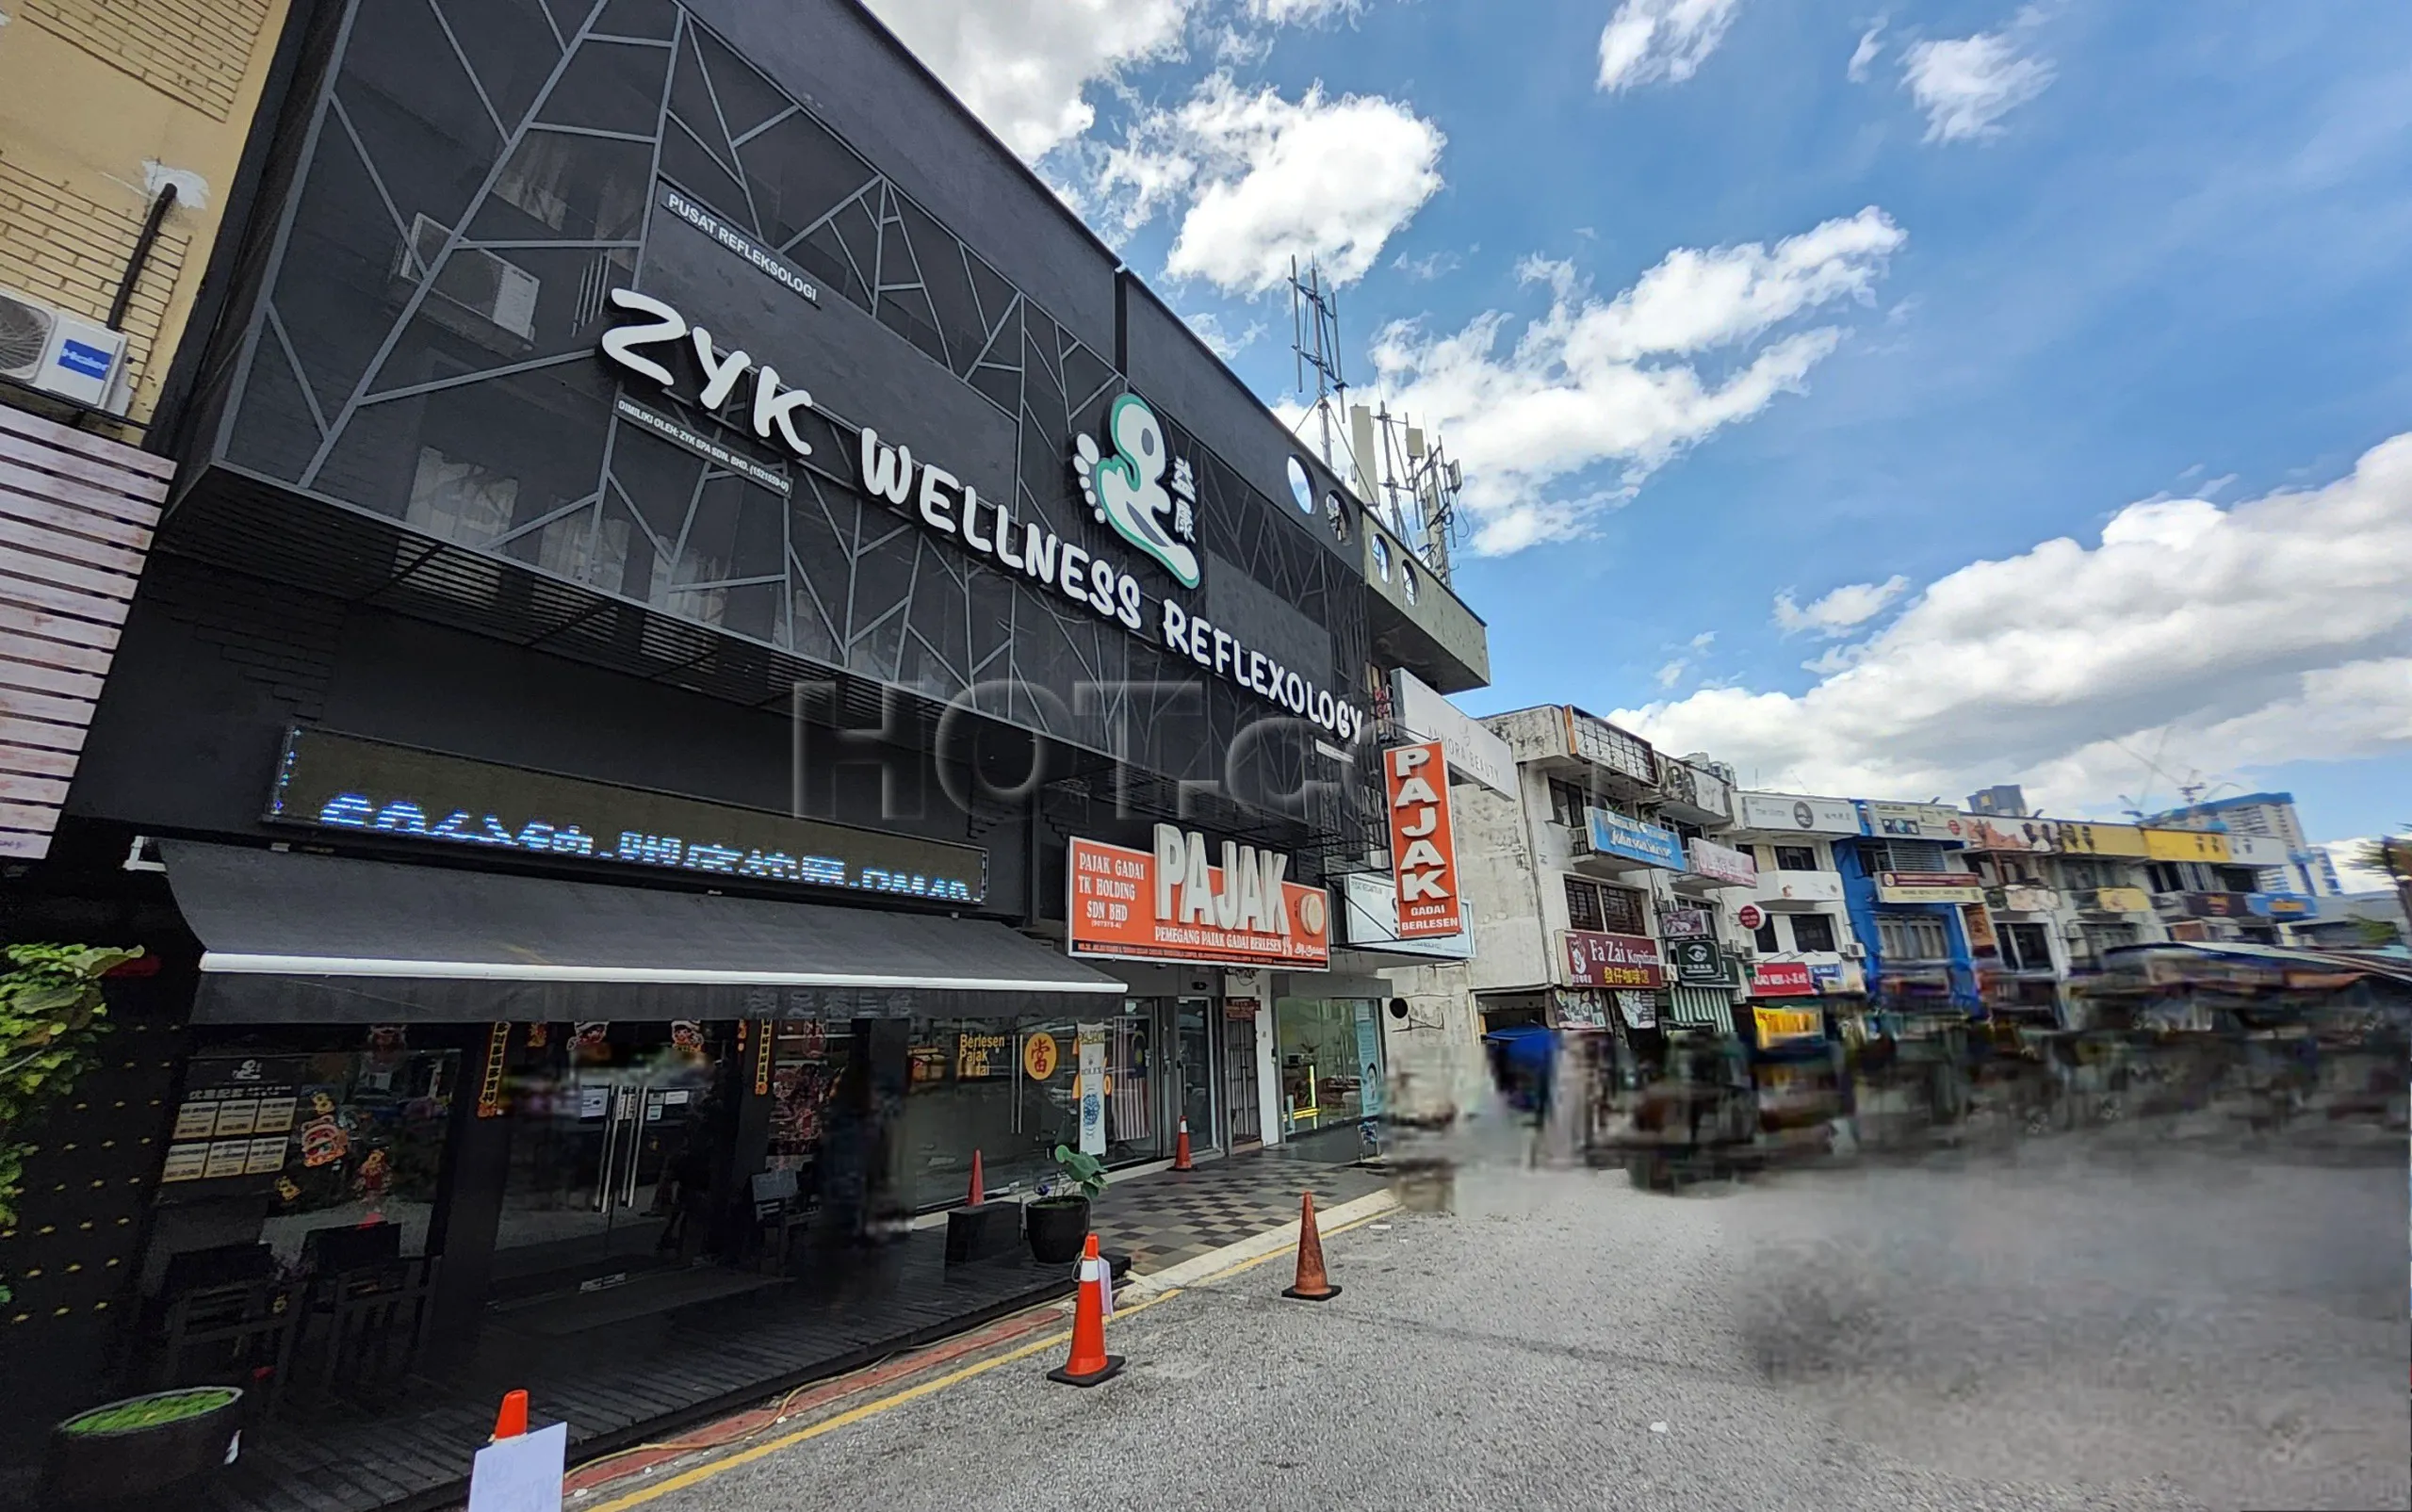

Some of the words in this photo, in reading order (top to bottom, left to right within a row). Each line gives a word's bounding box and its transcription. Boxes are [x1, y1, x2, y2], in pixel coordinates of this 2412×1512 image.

[668, 193, 718, 235] PUSAT
[718, 226, 817, 301] REFLEKSOLOGI
[618, 399, 653, 424] DIMILIKI
[678, 429, 695, 445] ZYK
[695, 438, 711, 453] SPA
[601, 287, 813, 456] ZYK
[861, 427, 1142, 629] WELLNESS
[1163, 597, 1363, 744] REFLEXOLOGY
[1393, 748, 1450, 902] PAJAK
[1079, 852, 1111, 874] PAJAK
[1115, 859, 1145, 881] GADAI
[1153, 822, 1291, 935] PAJAK
[1078, 875, 1092, 895] TK
[1096, 879, 1135, 902] HOLDING
[1086, 900, 1105, 919] SDN
[1109, 902, 1128, 921] BHD
[1410, 904, 1445, 916] GADAI
[1401, 918, 1458, 931] BERLESEN
[1155, 925, 1200, 945] PEMEGANG
[1226, 935, 1249, 951] GADAI
[1250, 935, 1281, 952] BERLESEN
[1589, 939, 1605, 962] Fa
[1605, 940, 1626, 963] Zai
[960, 1033, 1005, 1049] Berlesen
[959, 1049, 989, 1064] Pajak
